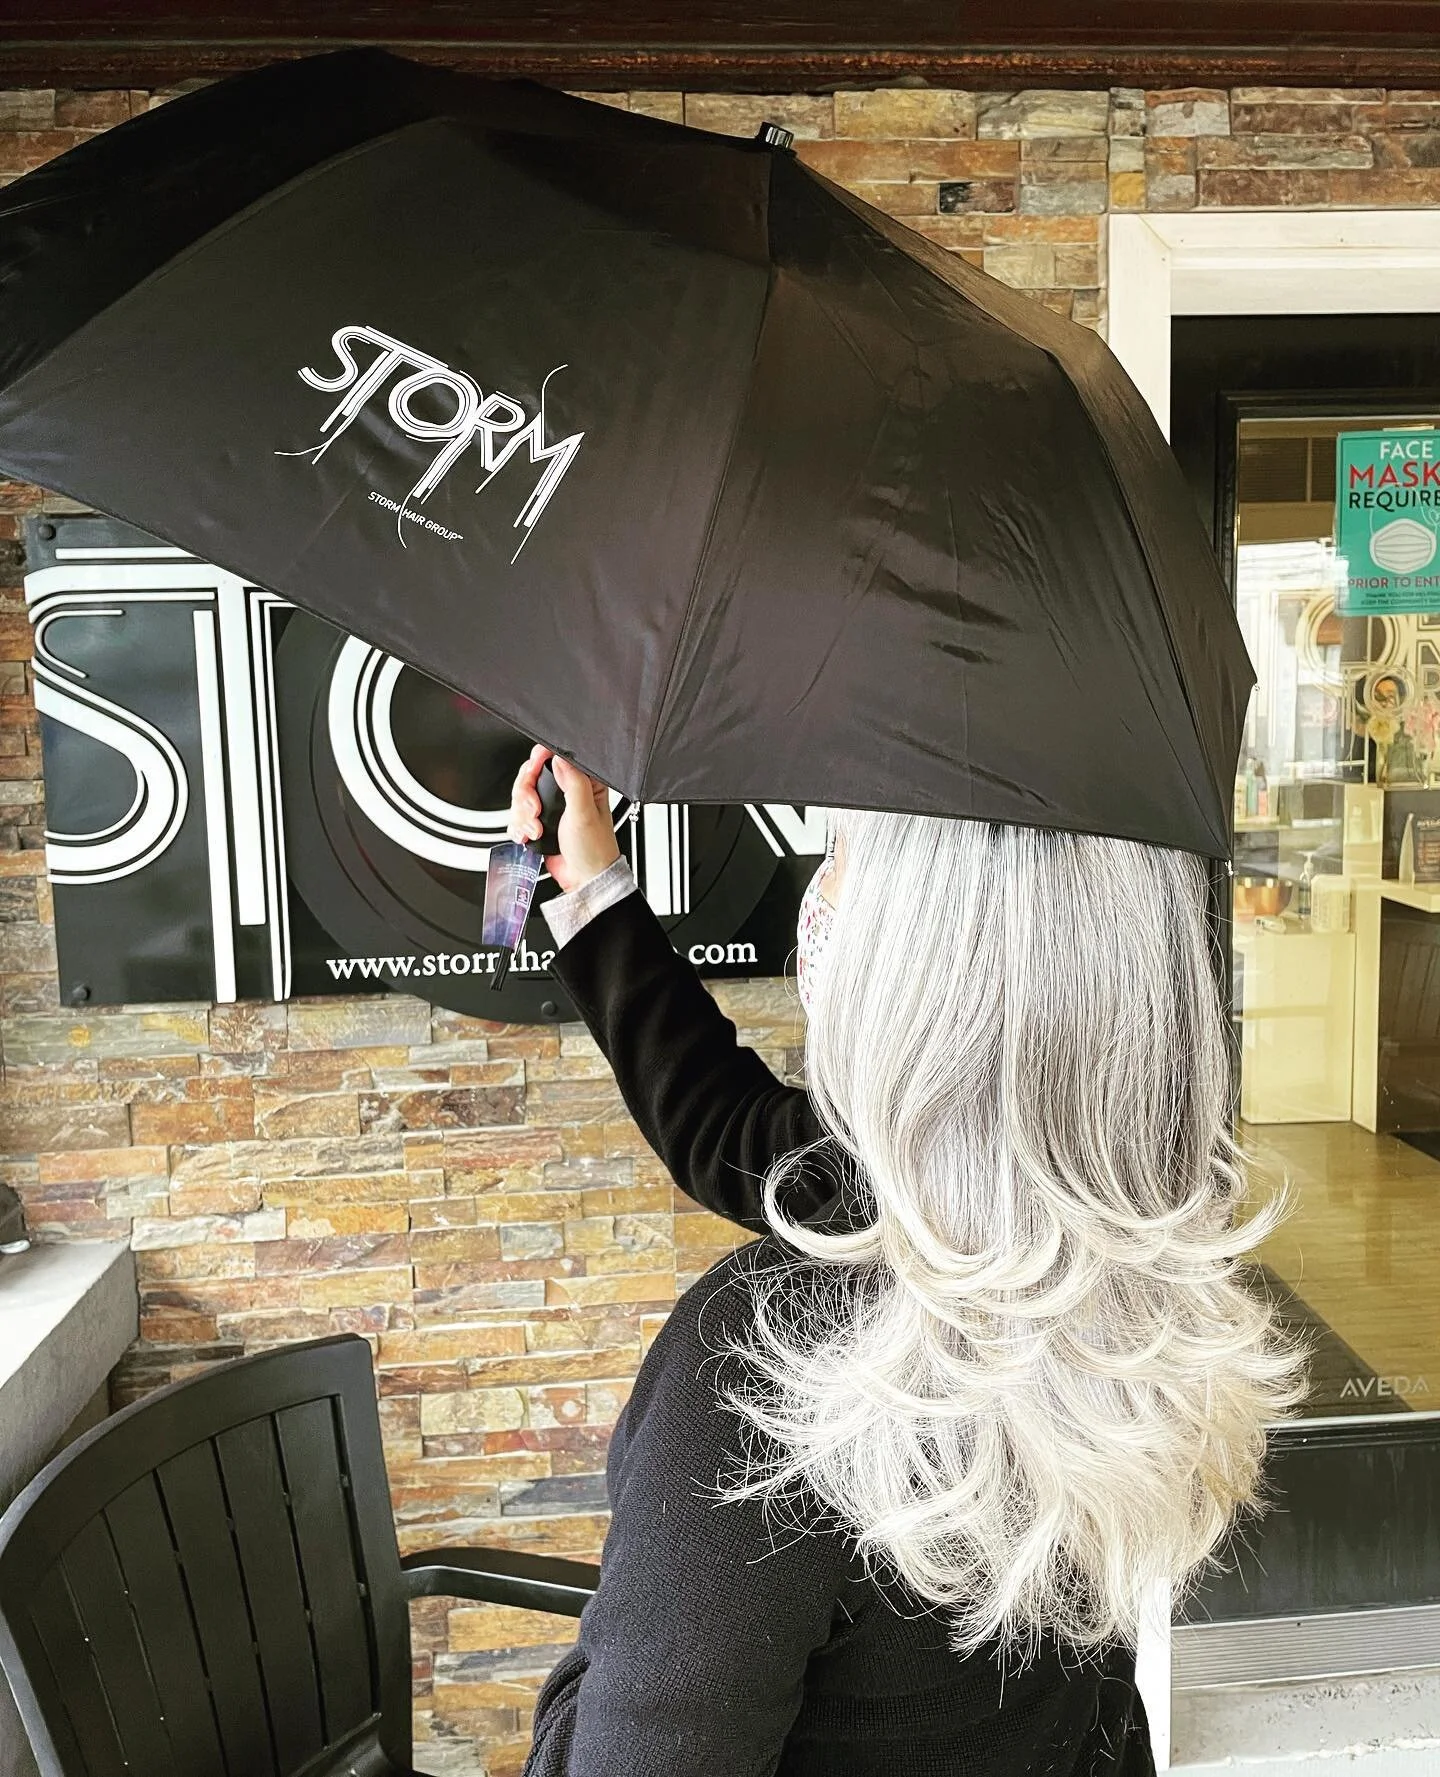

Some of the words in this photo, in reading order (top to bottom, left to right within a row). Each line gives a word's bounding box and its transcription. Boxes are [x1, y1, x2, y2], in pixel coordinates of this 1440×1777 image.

[274, 325, 585, 565] STORM
[1380, 440, 1433, 460] FACE
[1349, 461, 1440, 489] MASK
[368, 491, 401, 513] STORM
[402, 508, 426, 526] HAIR
[1348, 576, 1388, 589] PRIOR
[1394, 576, 1411, 588] TO
[1340, 1375, 1430, 1398] AVEDA
